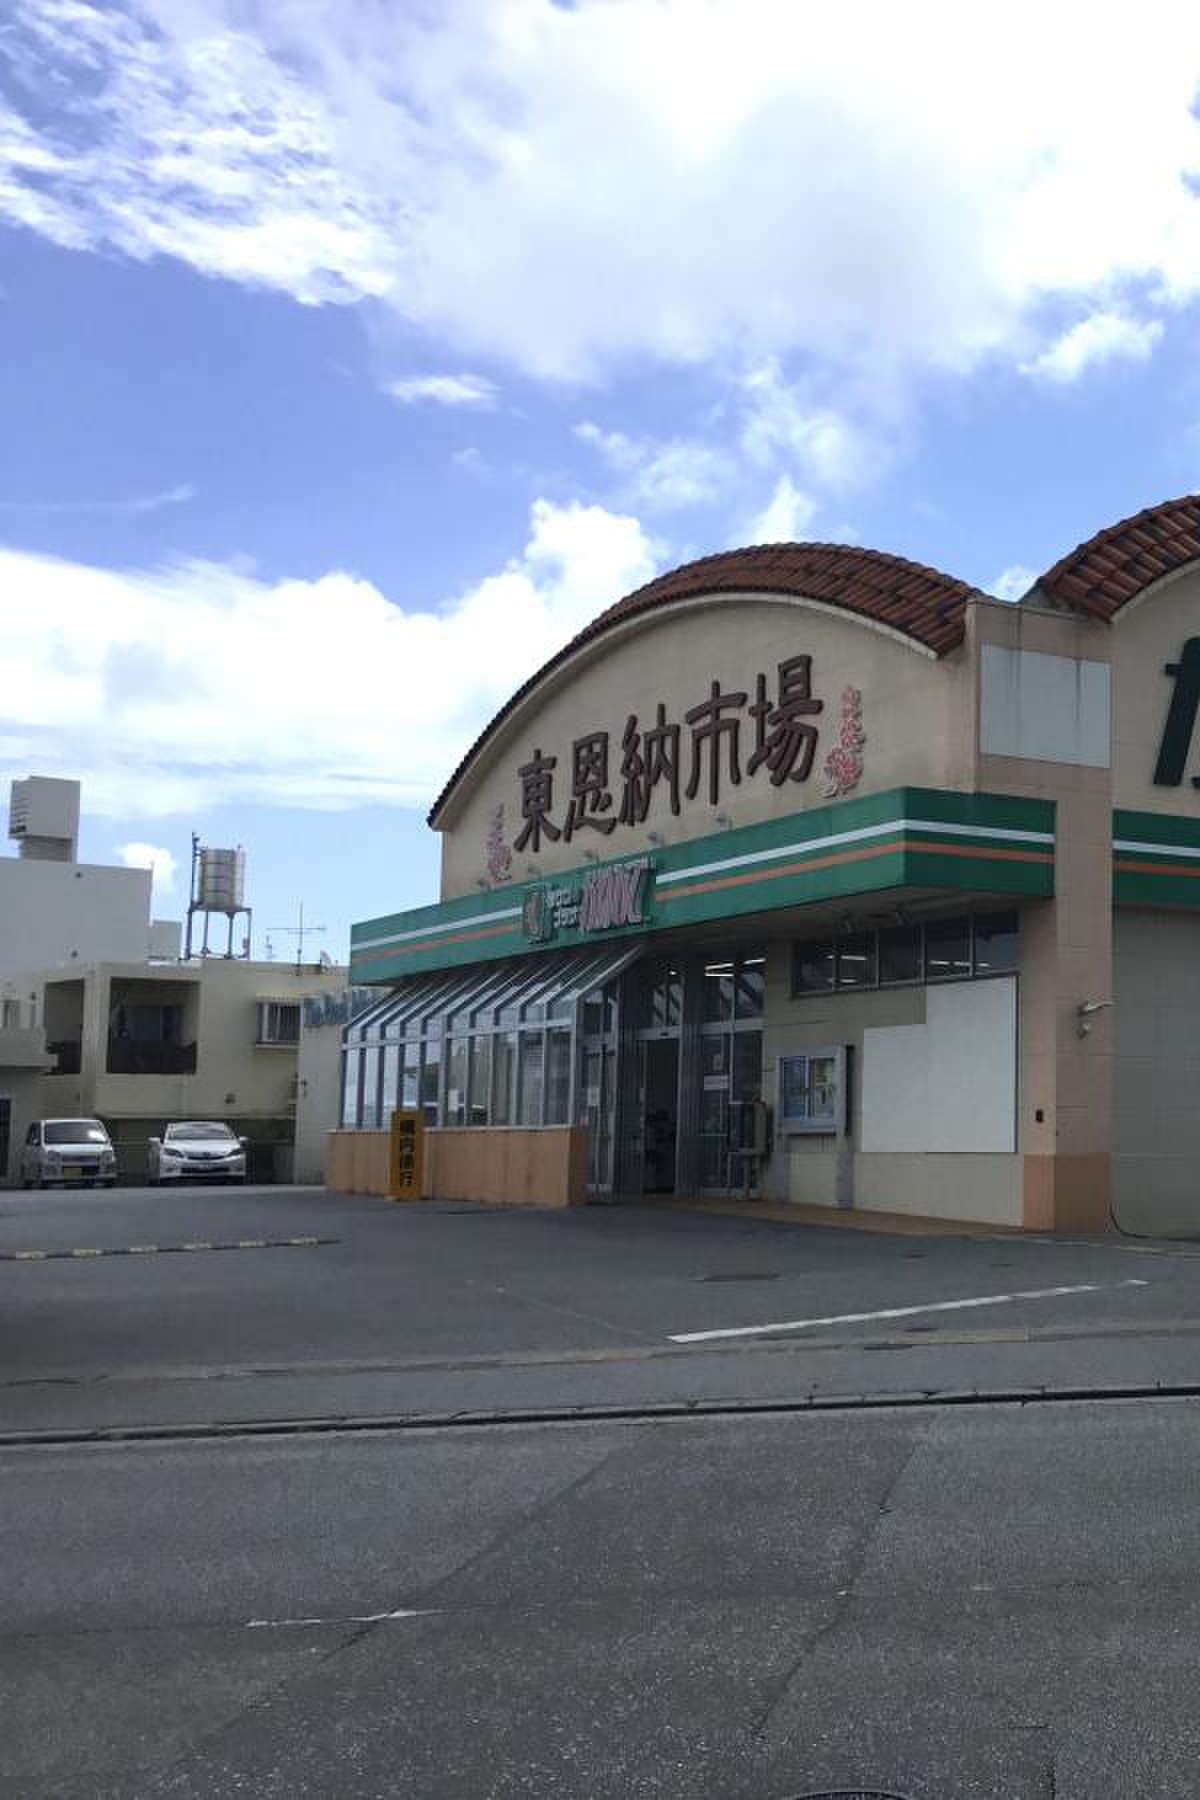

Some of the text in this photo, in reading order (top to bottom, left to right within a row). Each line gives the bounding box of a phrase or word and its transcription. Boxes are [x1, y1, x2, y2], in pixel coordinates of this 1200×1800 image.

[513, 653, 824, 853] 東恩納市場
